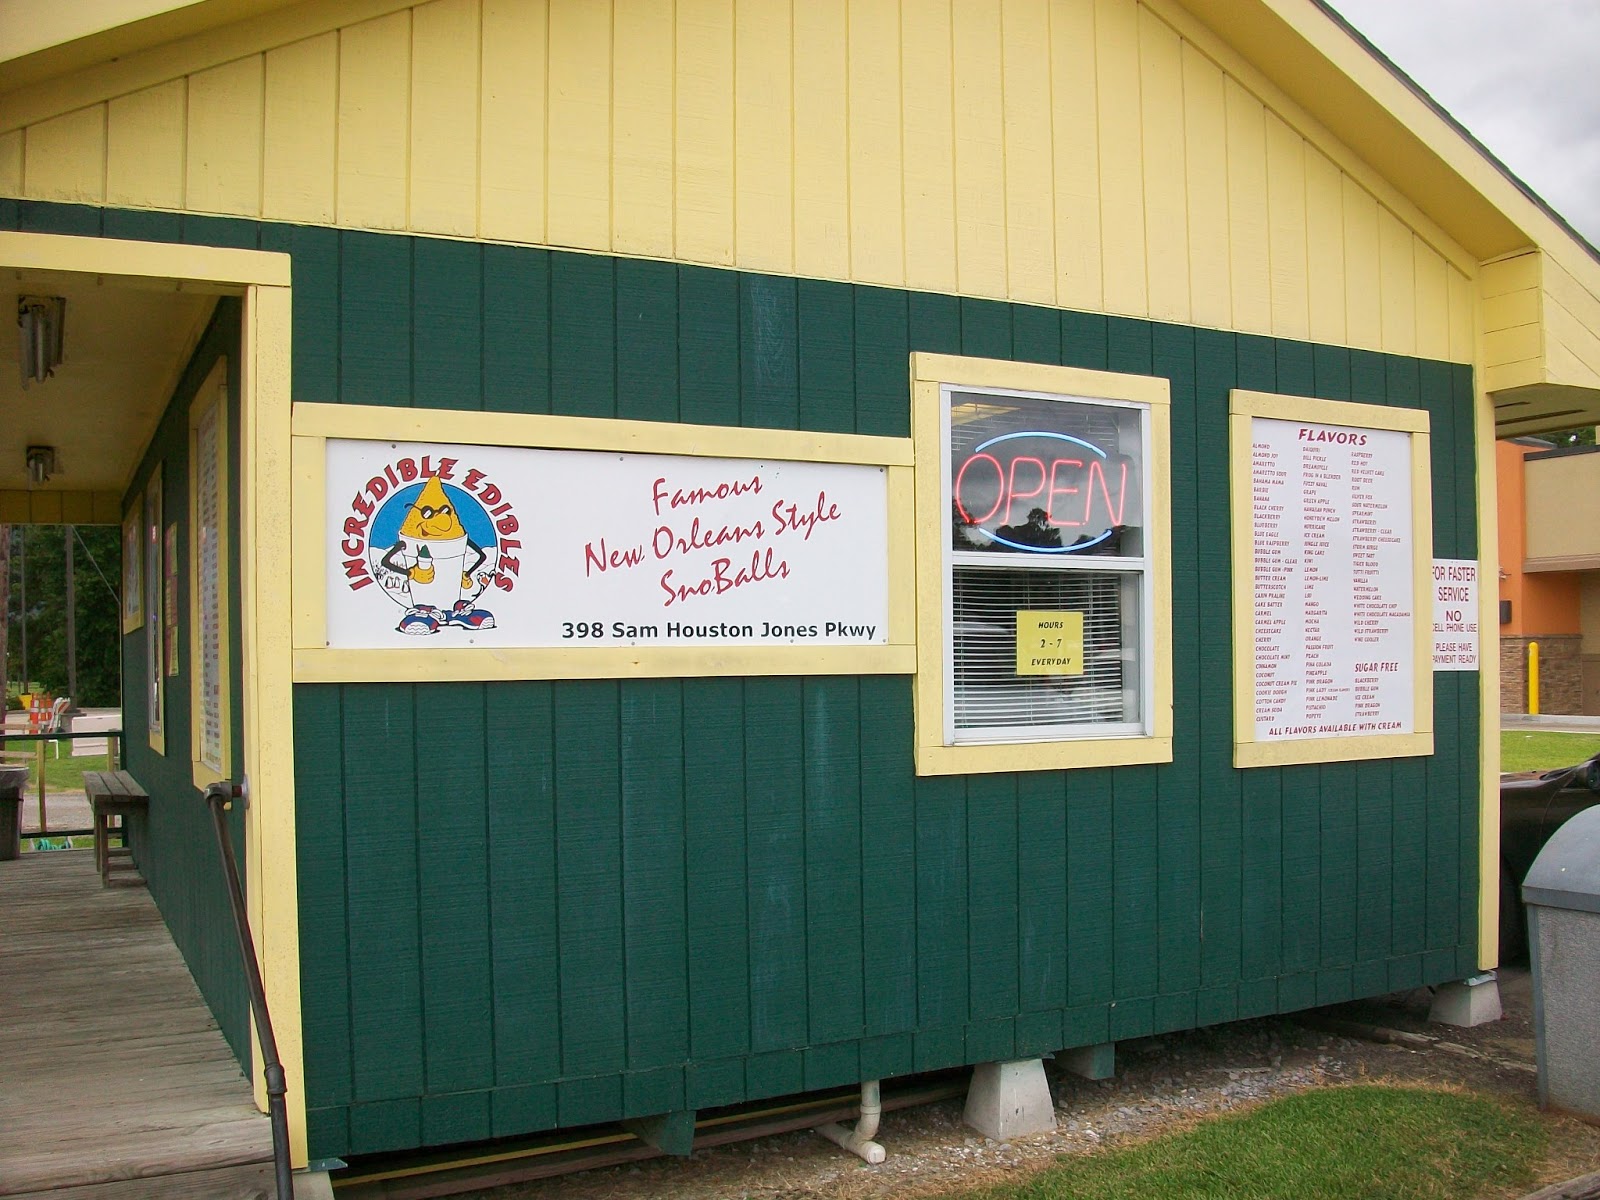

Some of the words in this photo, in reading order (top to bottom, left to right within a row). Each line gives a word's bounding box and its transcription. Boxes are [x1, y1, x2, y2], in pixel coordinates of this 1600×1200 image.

[1299, 429, 1367, 445] FLAVORS
[956, 453, 1127, 526] OPEN
[652, 476, 763, 516] Famous
[342, 455, 459, 591] INCREDIBLE
[462, 469, 522, 593] EDIBLES
[585, 538, 644, 577] New
[652, 517, 765, 559] Orleans
[771, 490, 842, 540] Style
[660, 547, 790, 607] SnoBalls
[1433, 566, 1446, 581] OR
[1449, 567, 1476, 581] FASTER
[1438, 587, 1469, 601] SERVICE
[1446, 611, 1461, 621] NO
[562, 622, 604, 638] 398
[612, 622, 658, 638] Sam
[667, 622, 753, 637] Houston
[761, 622, 818, 637] Jones
[825, 622, 876, 639] Pkwy
[1038, 621, 1064, 629] HOURS
[1433, 624, 1443, 632] ELL
[1447, 624, 1464, 632] PHONE
[1040, 639, 1045, 648] 2
[1057, 639, 1062, 648] 7
[1436, 643, 1456, 651] PLEASE
[1459, 643, 1472, 651] HAVE
[1031, 658, 1071, 666] EVERYDAY
[1459, 655, 1476, 663] READY
[1355, 663, 1378, 672] SUGAR
[1381, 663, 1398, 672] FREE
[1285, 726, 1317, 734] FLAVORS
[1319, 724, 1357, 732] AVAILABLE
